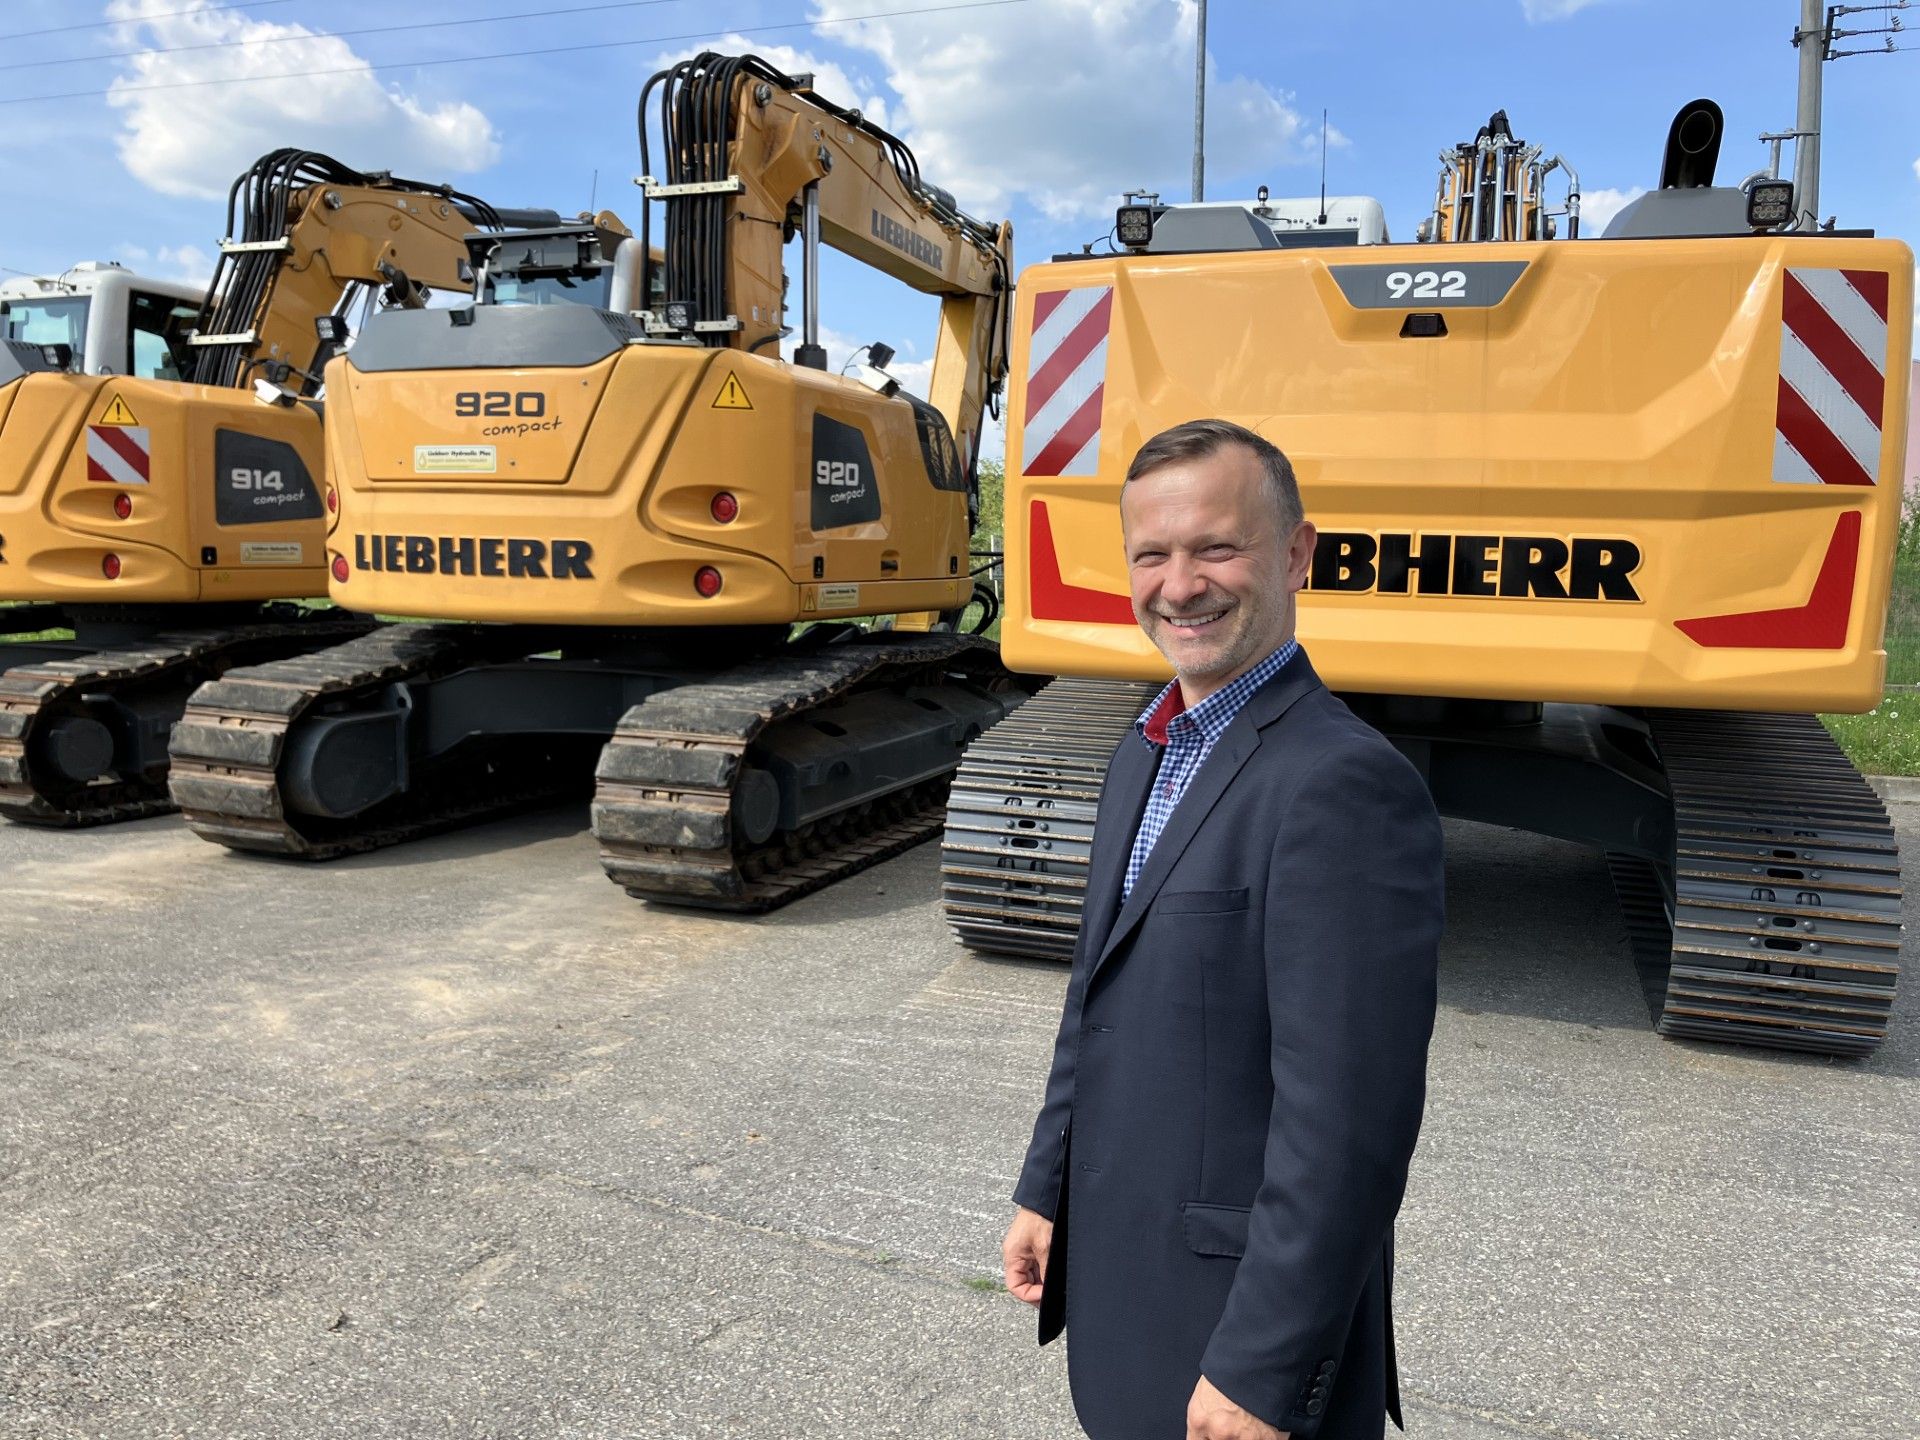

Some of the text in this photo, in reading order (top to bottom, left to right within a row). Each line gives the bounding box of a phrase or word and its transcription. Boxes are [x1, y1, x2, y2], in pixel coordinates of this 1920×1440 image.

[872, 208, 943, 271] LIEBHERR
[1386, 270, 1467, 299] 922
[455, 391, 546, 418] 920
[482, 415, 563, 438] compact
[231, 468, 284, 491] 914
[816, 460, 860, 487] 920
[253, 488, 305, 506] compact
[830, 484, 866, 504] compact
[354, 533, 596, 580] LIEBHERR
[1300, 532, 1642, 602] BHERR
